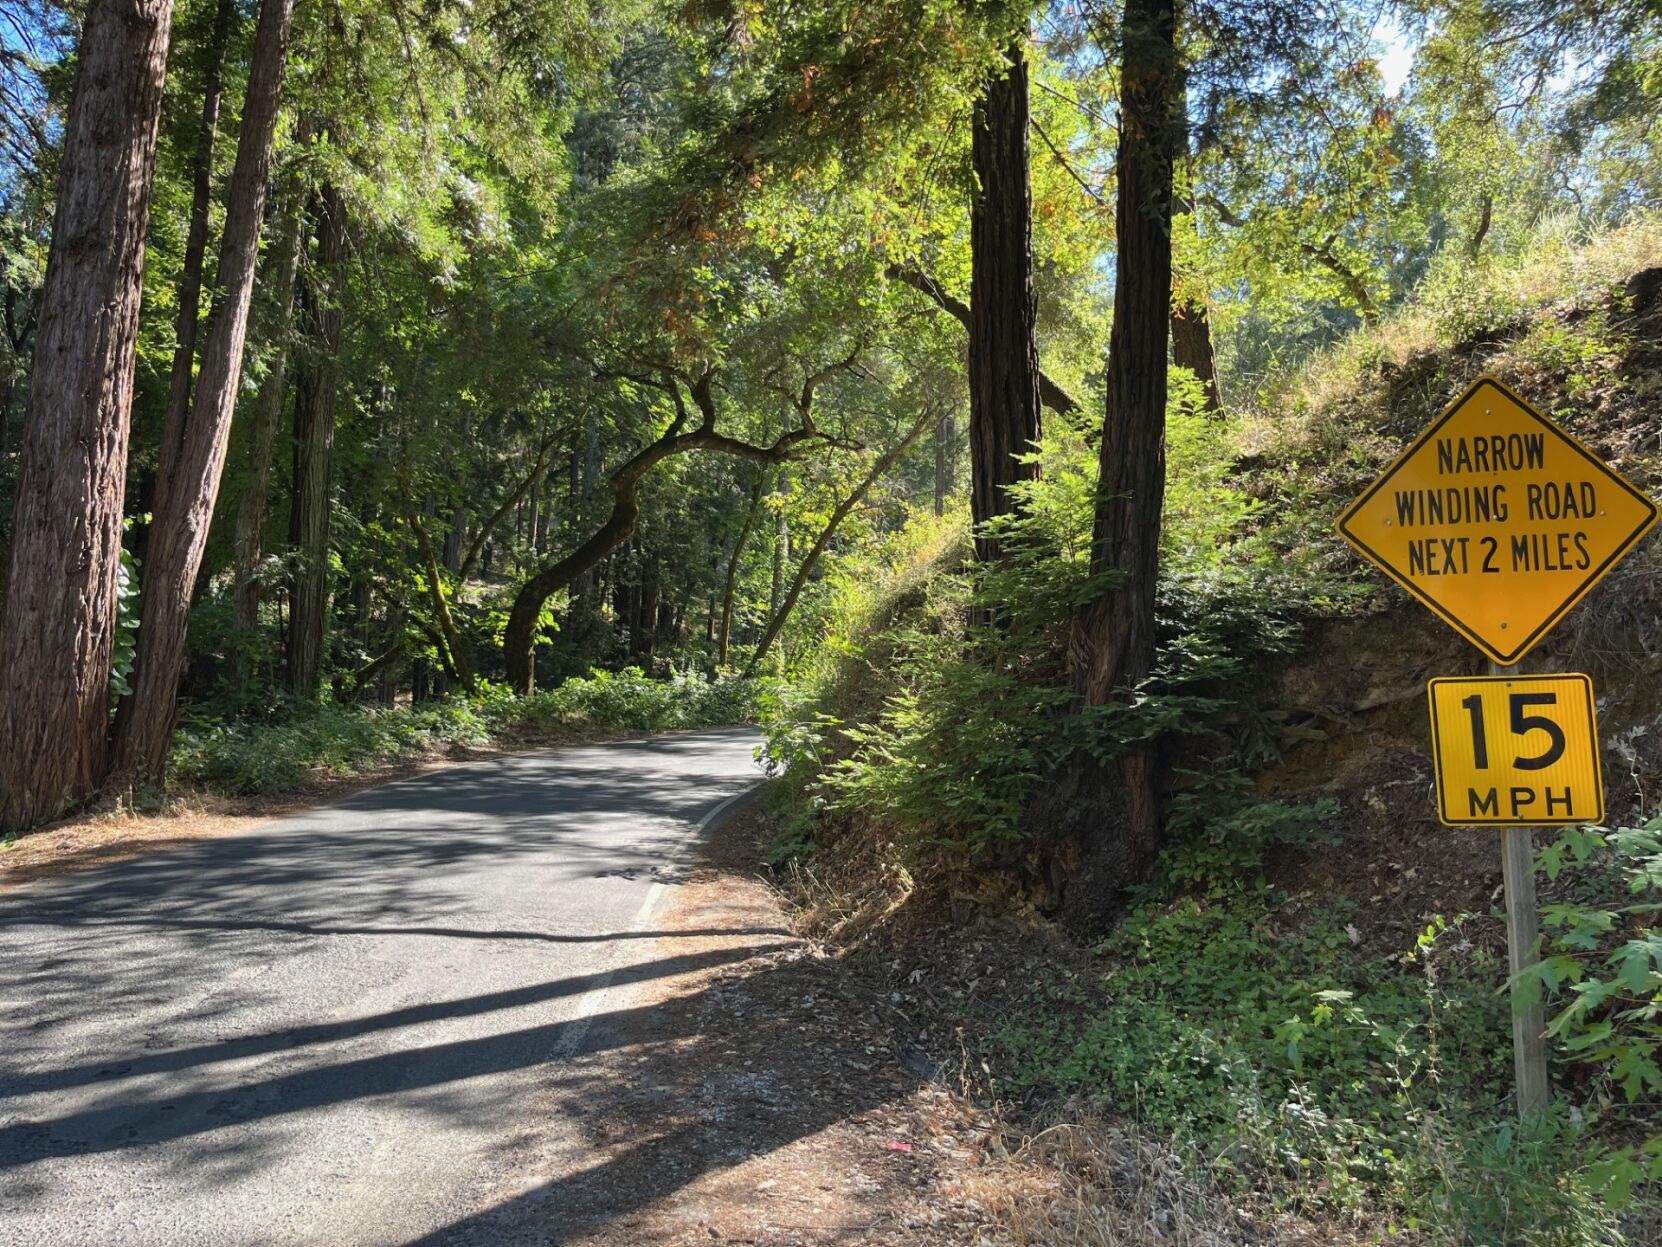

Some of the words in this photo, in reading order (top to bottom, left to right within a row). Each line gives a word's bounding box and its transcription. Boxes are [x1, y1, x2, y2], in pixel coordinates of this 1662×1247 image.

[1436, 433, 1545, 475] NARROW
[1394, 484, 1508, 527] WINDING
[1527, 481, 1597, 520] ROAD
[1408, 536, 1470, 576] NEXT
[1480, 536, 1500, 573] 2
[1510, 531, 1591, 572] MILES
[1461, 692, 1566, 771] 15
[1467, 786, 1573, 817] MPH
